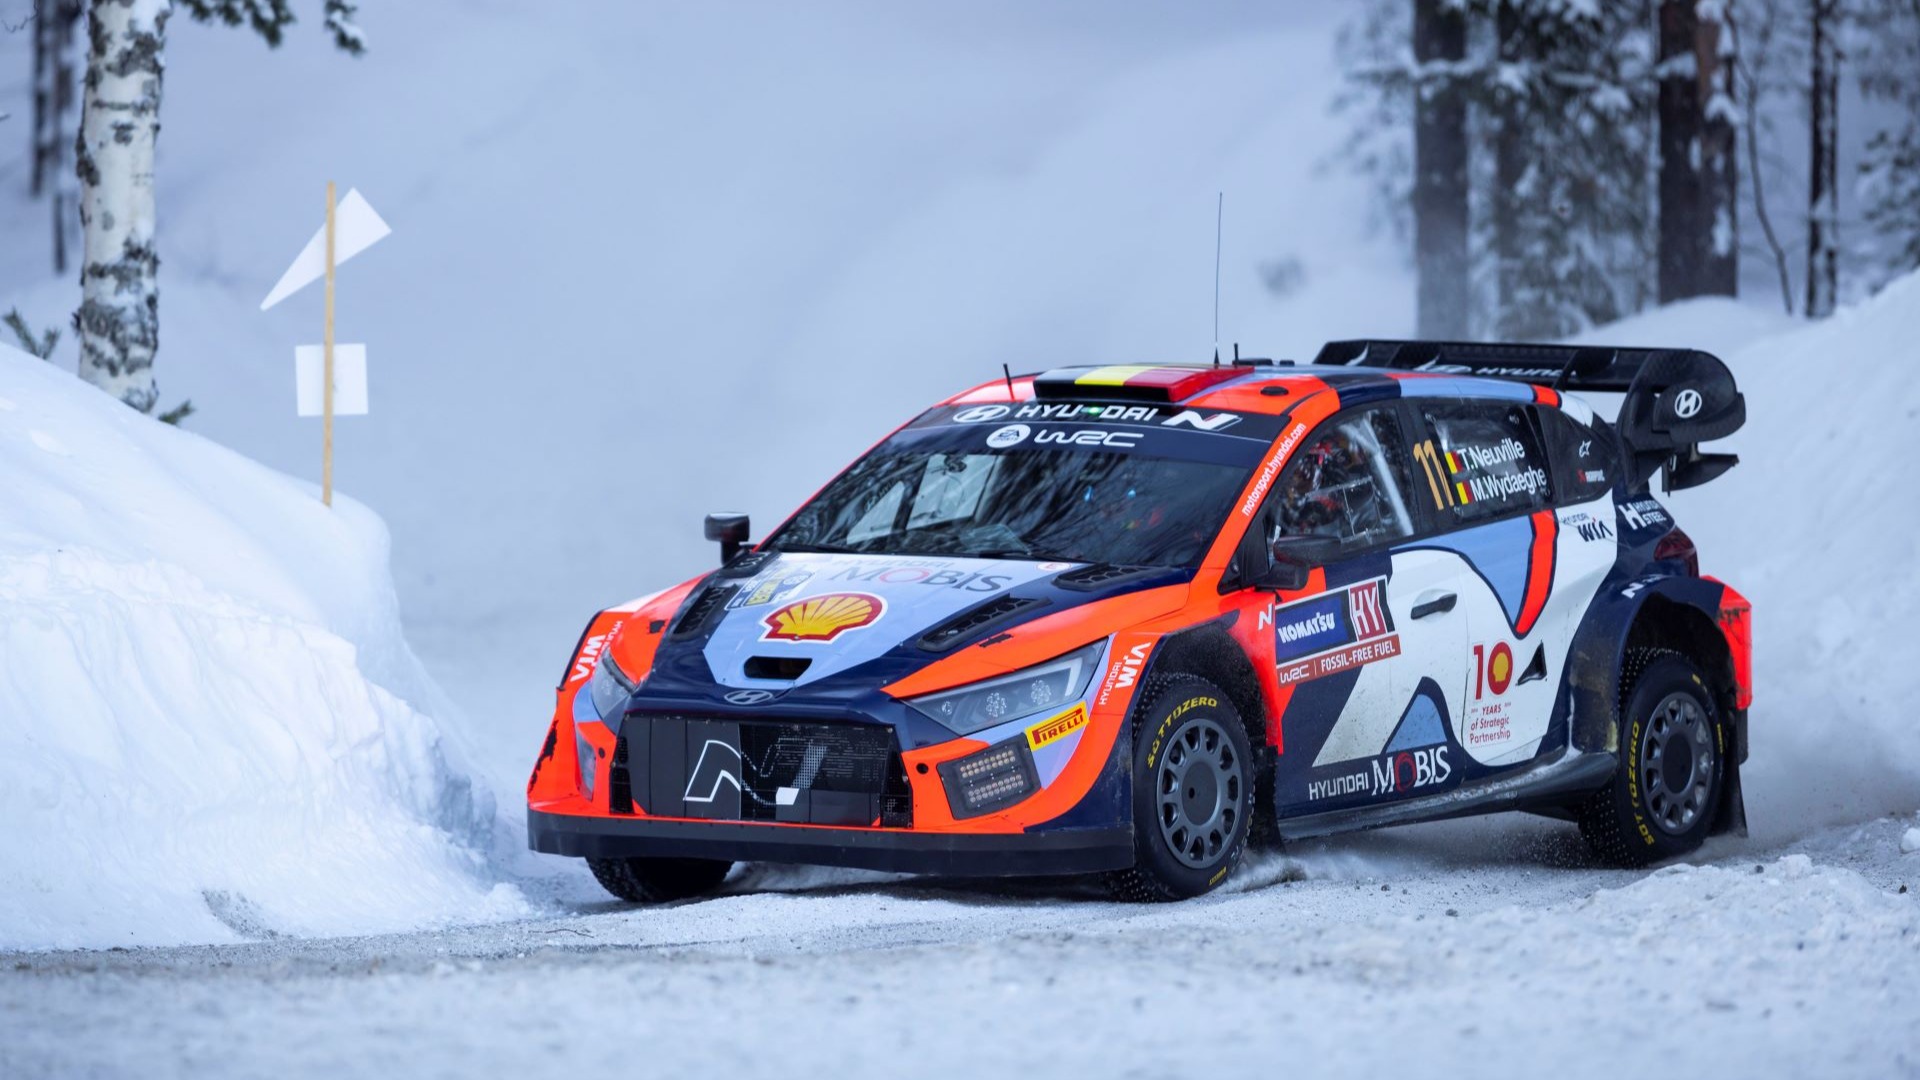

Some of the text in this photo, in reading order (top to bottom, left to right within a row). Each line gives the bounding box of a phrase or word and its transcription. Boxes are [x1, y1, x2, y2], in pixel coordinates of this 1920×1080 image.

[1014, 404, 1159, 421] HYUDAI
[1034, 429, 1144, 447] WRC
[1456, 437, 1526, 471] T.Neuville
[1241, 422, 1307, 517] motorsport.hyundai.com
[1413, 439, 1455, 510] 11
[1469, 465, 1547, 502] M.Wydaeghe
[1577, 517, 1614, 543] WIA
[1642, 512, 1667, 525] STEEL
[828, 566, 1012, 592] MOBIS
[1258, 603, 1273, 631] N
[1278, 612, 1336, 643] KOMATSU
[1351, 586, 1381, 636] HY
[570, 634, 606, 682] WIA
[1115, 641, 1152, 689] WIA
[1321, 640, 1396, 673] FOSSIL-FREE FUEL
[1473, 641, 1513, 700] 10
[1098, 661, 1122, 705] HYUNDAI
[1280, 664, 1310, 684] WRC
[1032, 707, 1084, 745] PIRELLI
[1471, 714, 1510, 730] of Strategic
[1482, 704, 1502, 715] YEARS
[1146, 697, 1218, 768] SOTTOZERO
[1469, 727, 1511, 744] Partnership
[1309, 745, 1451, 800] HYUNDAI MOBIS
[1628, 721, 1655, 845] SOTTOZERO
